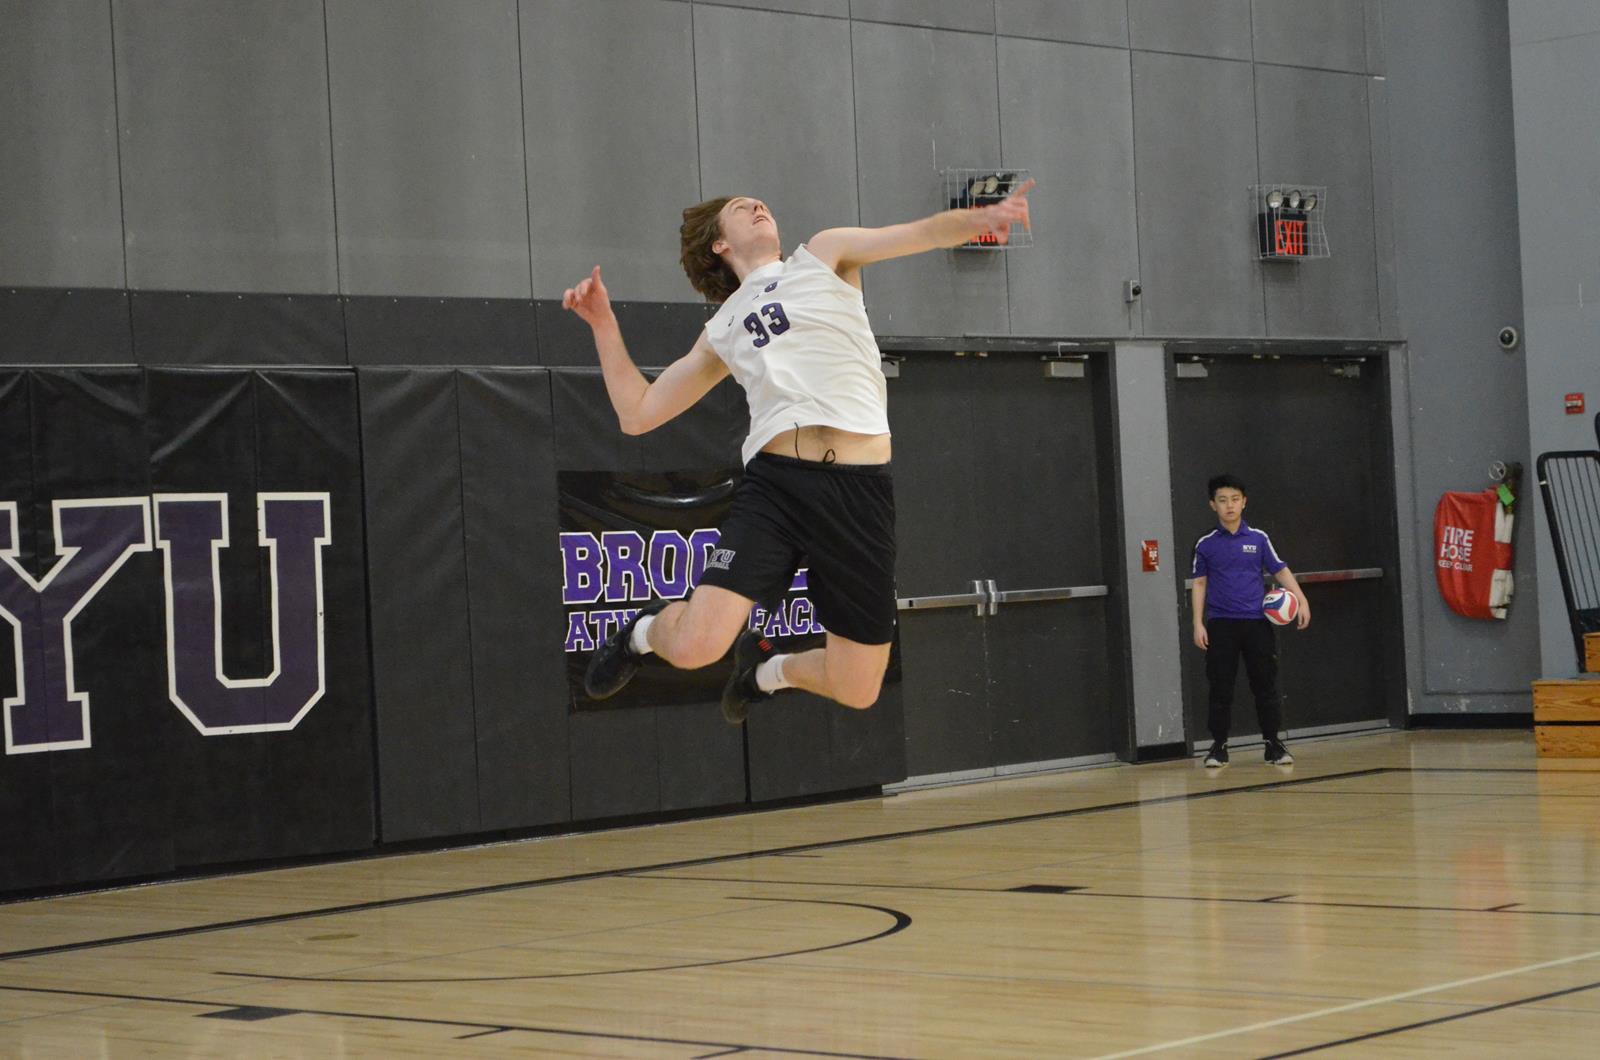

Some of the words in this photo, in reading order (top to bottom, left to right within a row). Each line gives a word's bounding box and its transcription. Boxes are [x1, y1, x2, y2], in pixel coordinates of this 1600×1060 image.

[1275, 219, 1304, 256] EXIT
[744, 302, 790, 348] 33
[1444, 526, 1474, 547] FIRE
[559, 528, 721, 604] BROO
[708, 548, 736, 564] YU
[1440, 543, 1472, 562] HOSE
